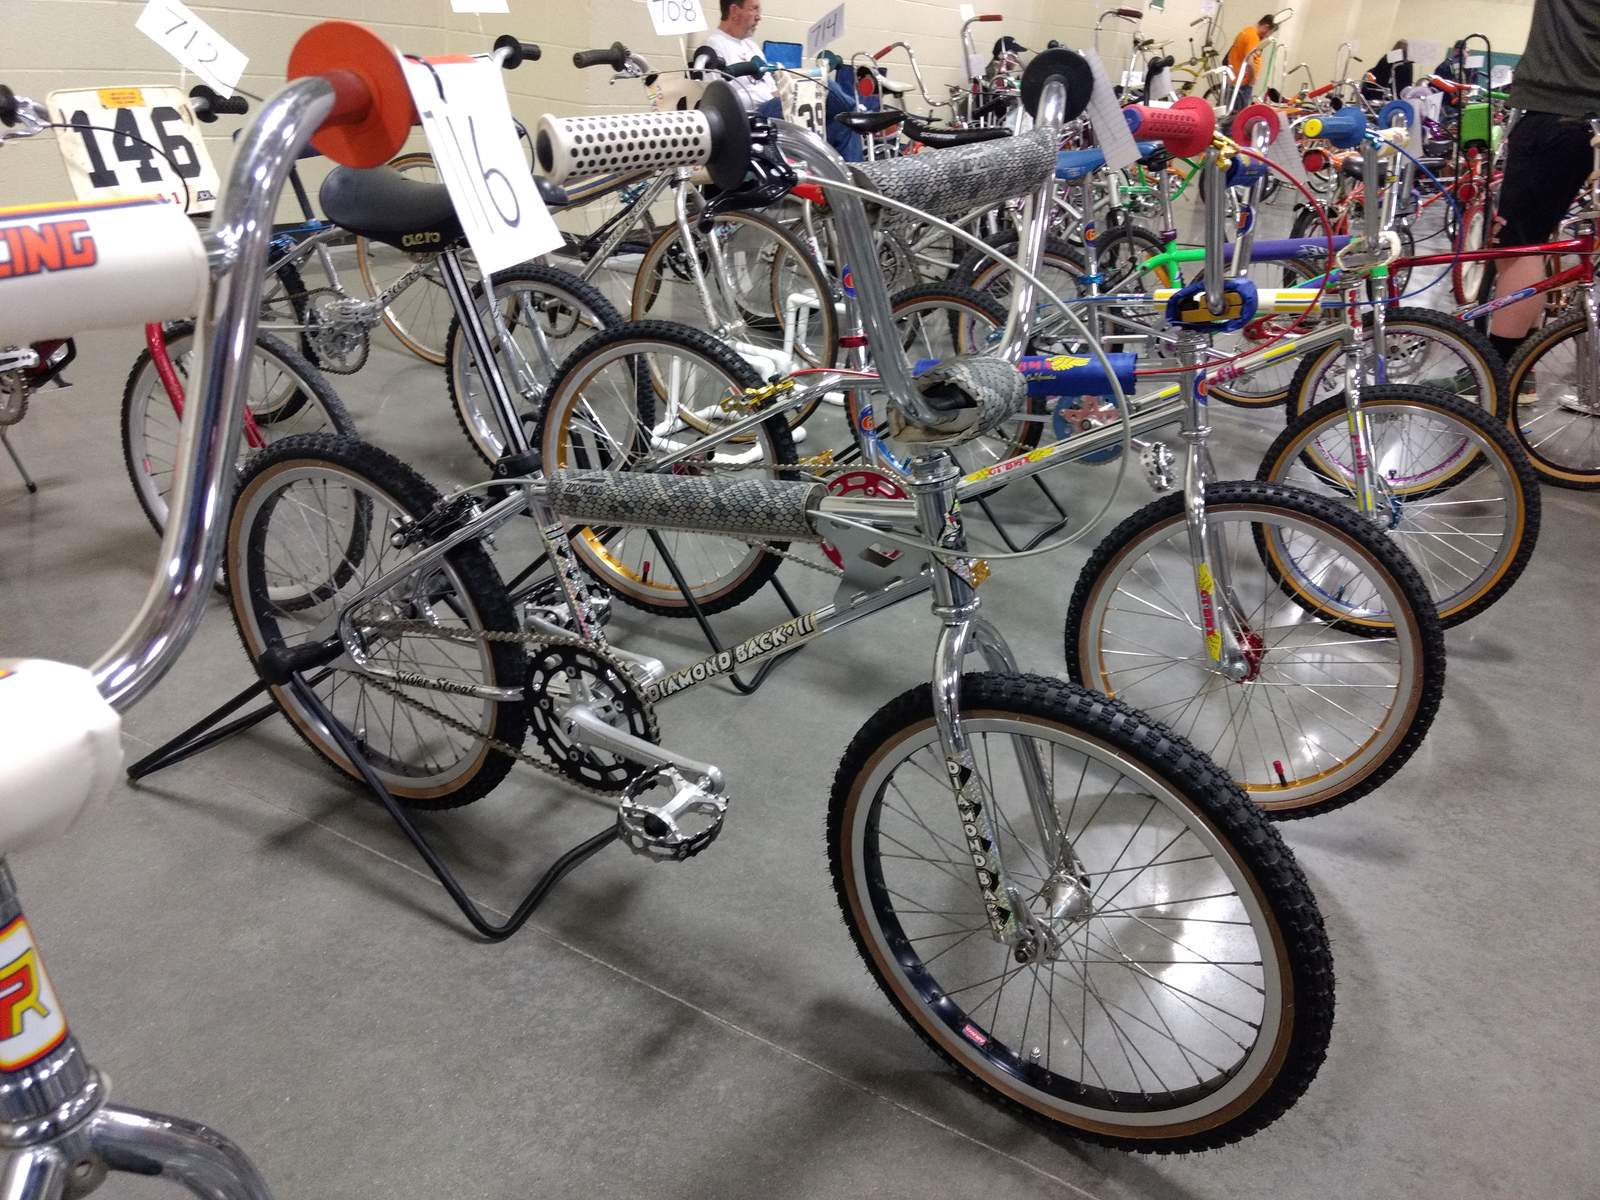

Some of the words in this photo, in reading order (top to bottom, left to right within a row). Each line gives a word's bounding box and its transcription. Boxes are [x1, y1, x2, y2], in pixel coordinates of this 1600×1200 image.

[164, 6, 219, 63] 712
[70, 106, 201, 189] 146
[402, 232, 441, 247] aero
[648, 650, 733, 703] DIAMOND
[733, 623, 789, 664] BACK
